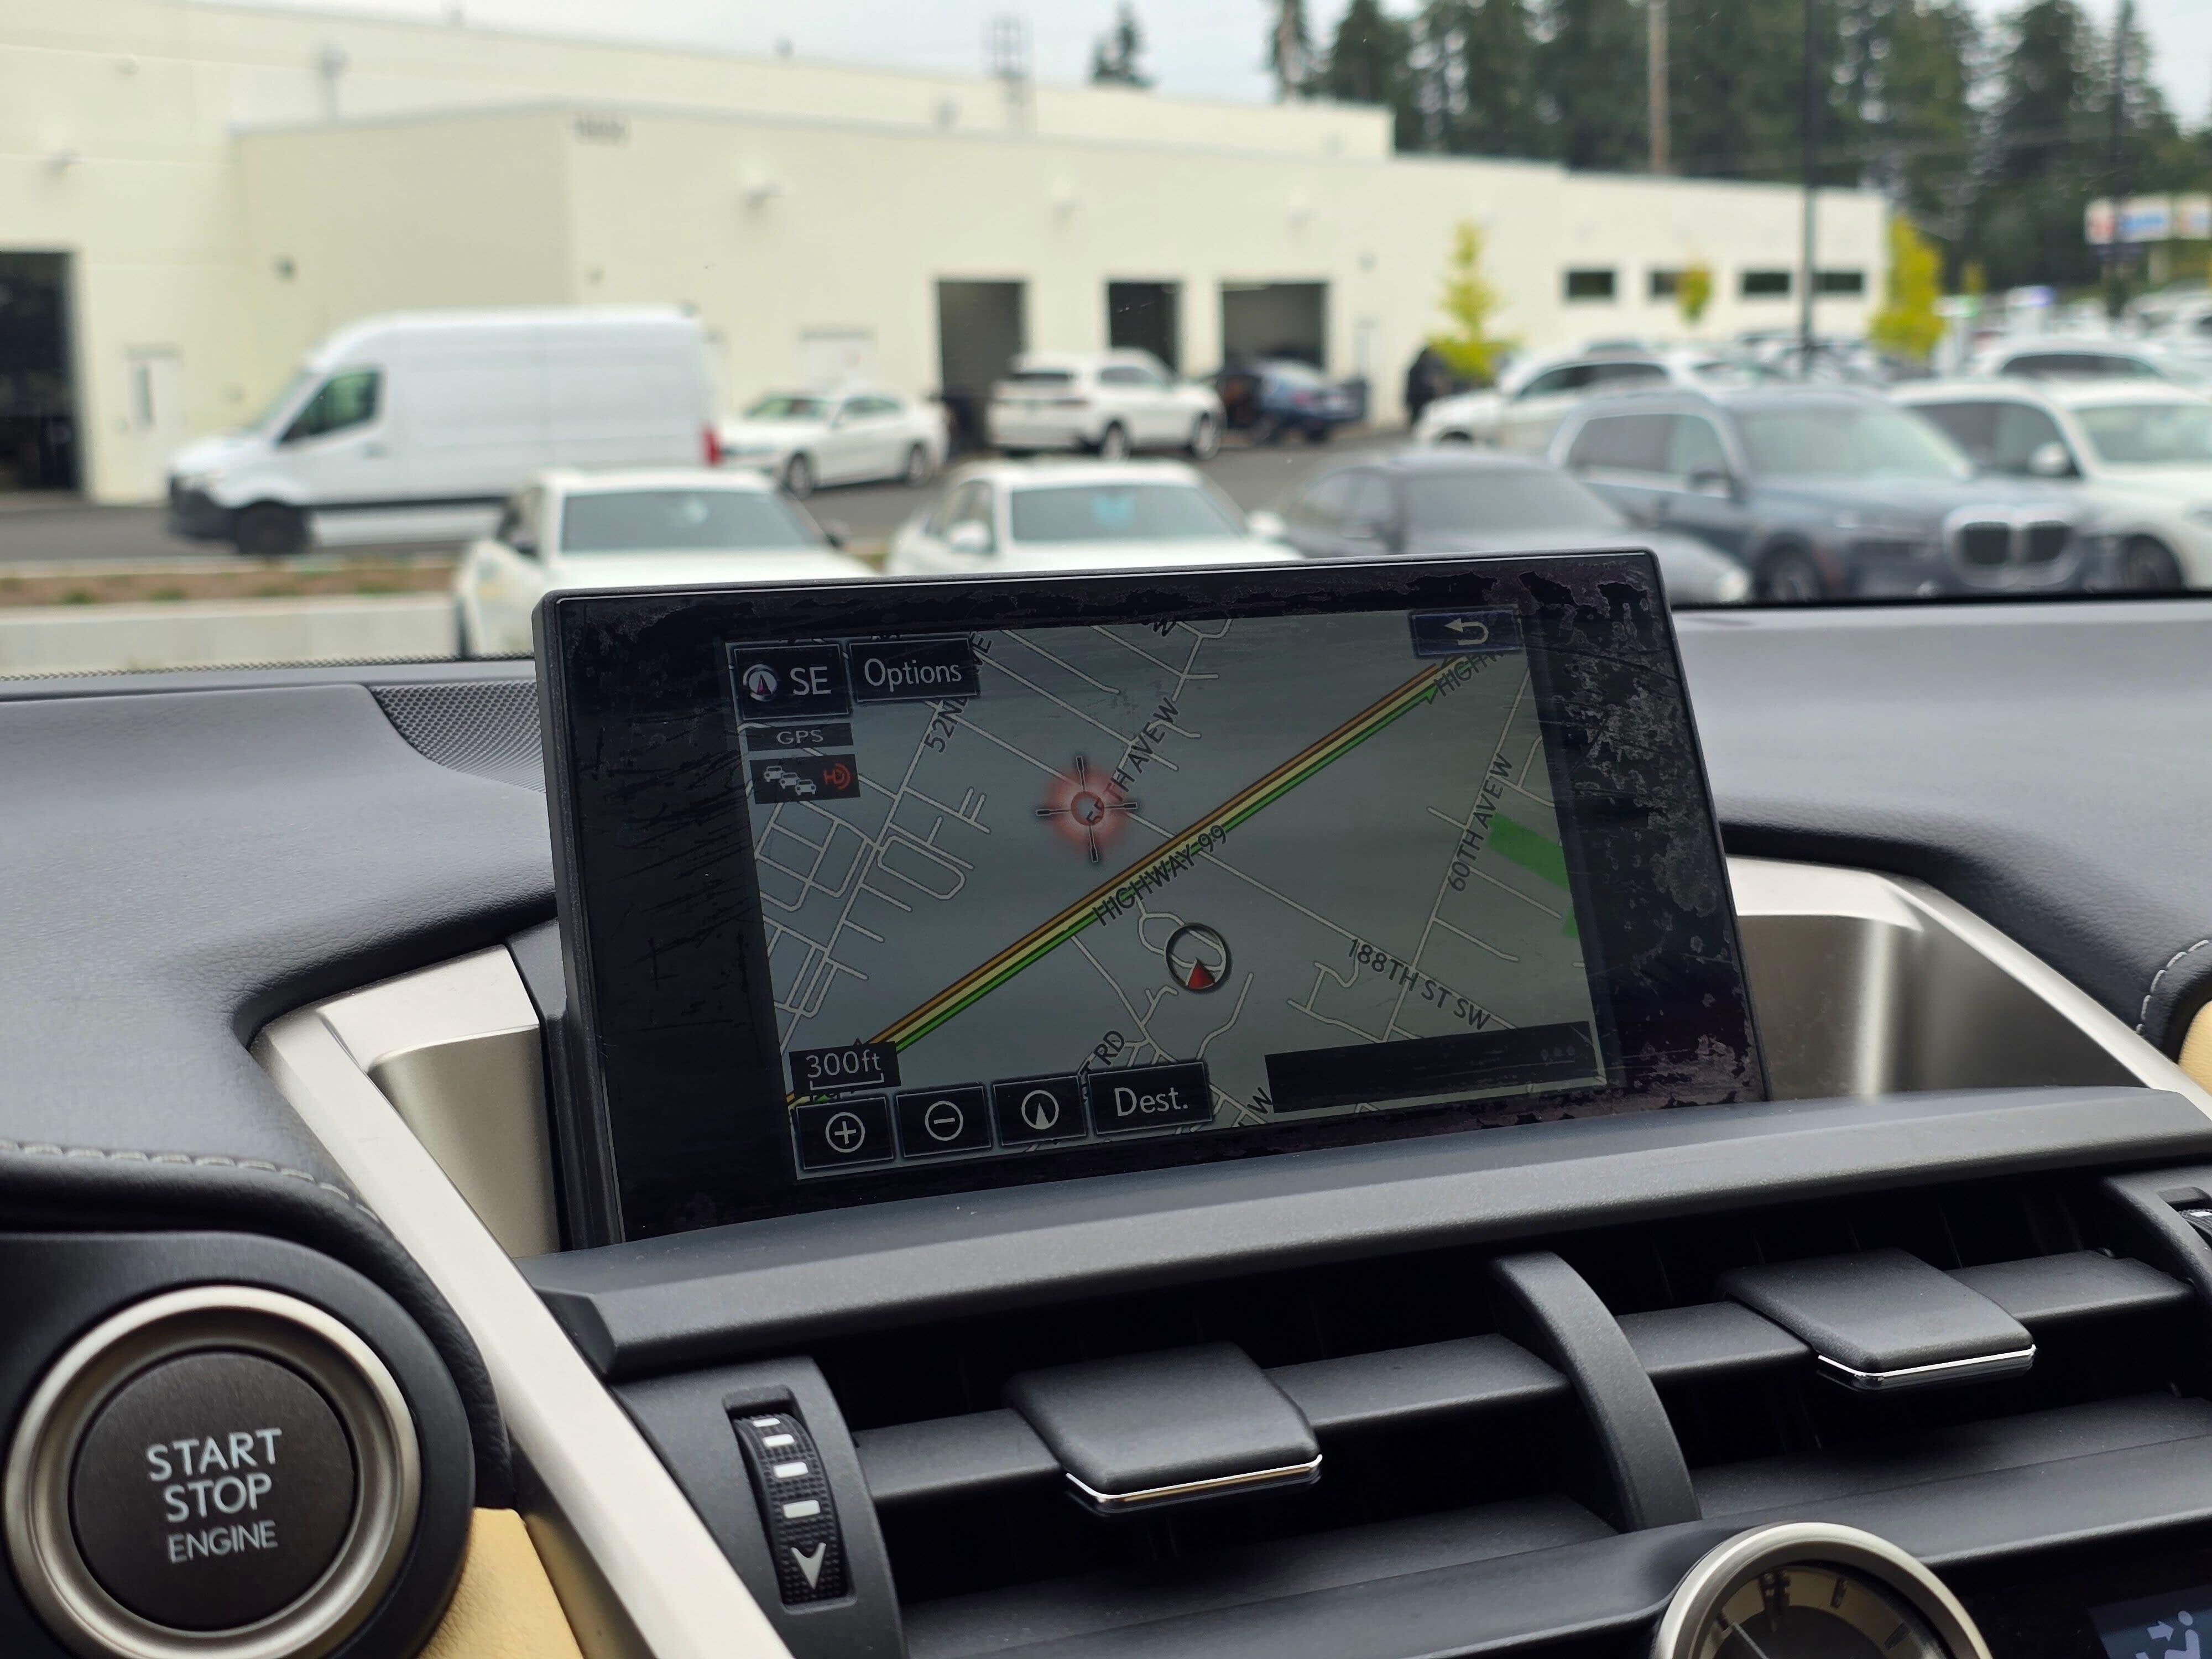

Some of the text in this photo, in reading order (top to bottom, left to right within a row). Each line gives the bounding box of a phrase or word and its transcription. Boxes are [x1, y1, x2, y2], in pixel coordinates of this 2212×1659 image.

[790, 666, 831, 695] SE
[864, 658, 963, 692] Options
[776, 730, 824, 745] GPS
[1128, 721, 1166, 774] AVE
[1152, 697, 1179, 723] W
[1447, 752, 1513, 893] 60TH AVE W
[1092, 825, 1227, 927] HIGHWAY 99
[1348, 938, 1491, 1030] 188TH ST SW
[806, 1049, 882, 1078] 300ft
[1093, 1030, 1125, 1066] RD
[1114, 1087, 1188, 1117] Dest.
[1246, 1087, 1272, 1115] W
[145, 1427, 283, 1482] START
[163, 1472, 273, 1522] STOP
[167, 1520, 279, 1564] ENGINE
